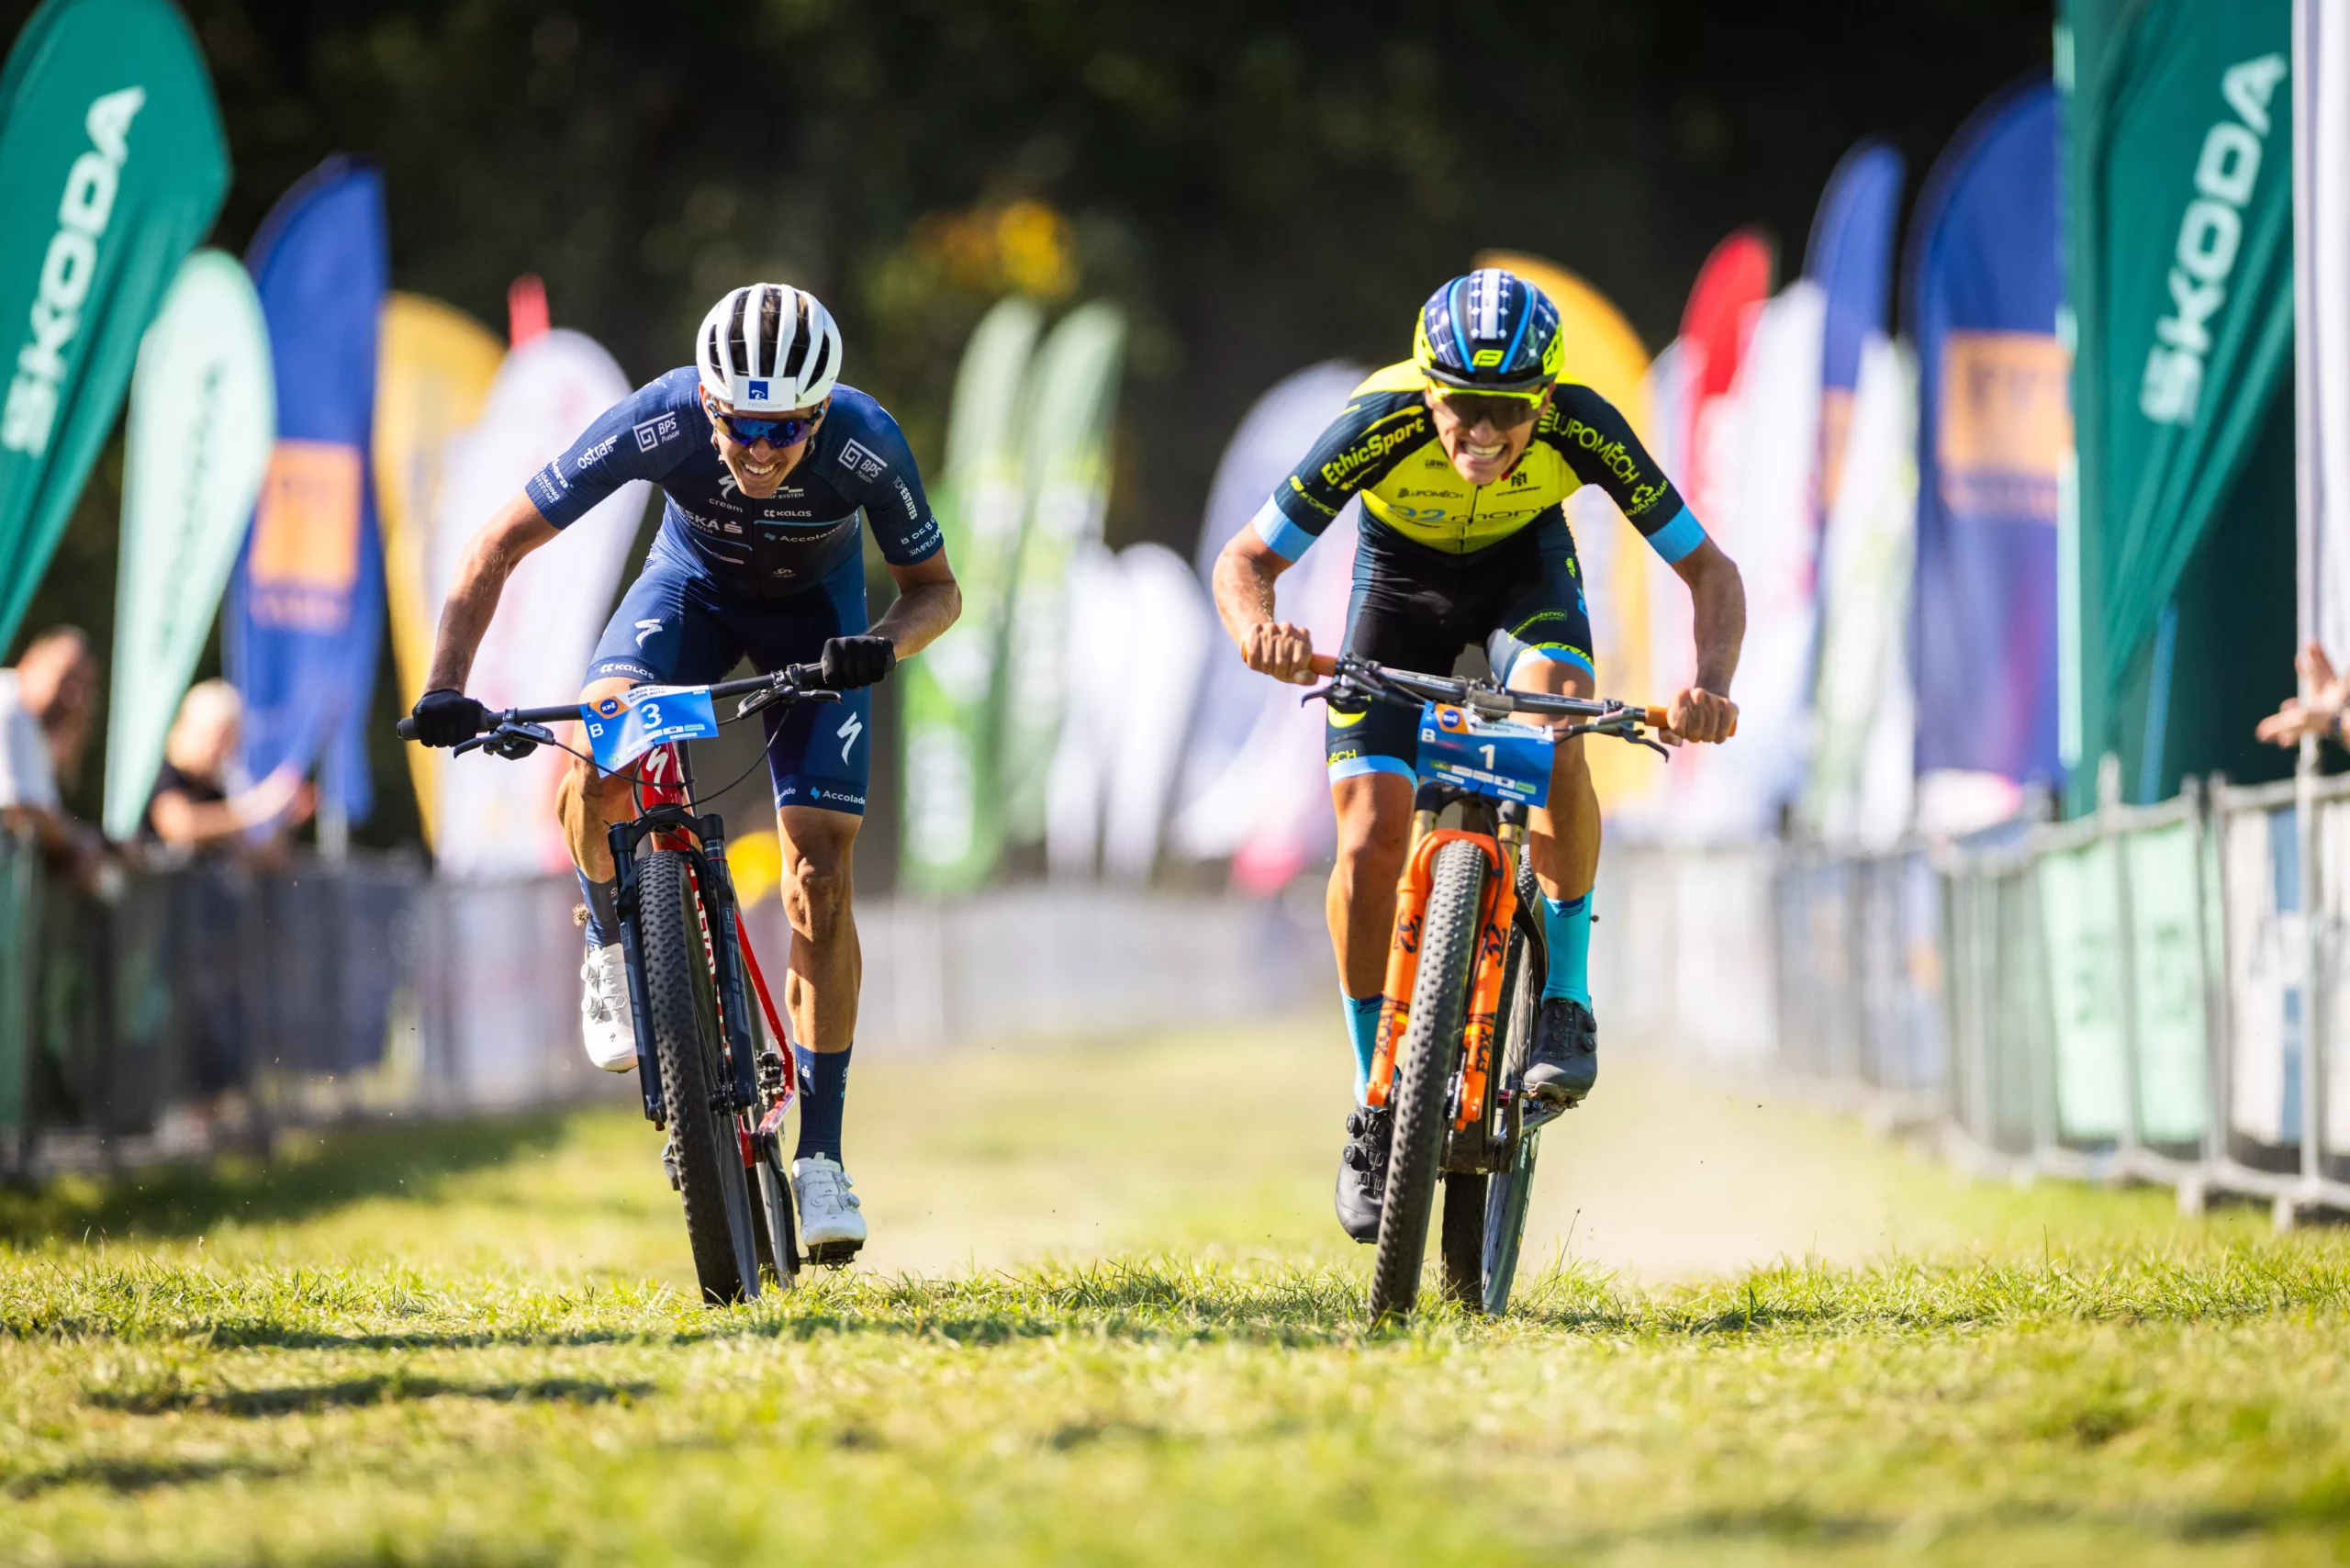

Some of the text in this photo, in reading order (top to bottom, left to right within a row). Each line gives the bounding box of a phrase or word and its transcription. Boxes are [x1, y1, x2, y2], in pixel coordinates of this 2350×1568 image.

[658, 417, 677, 435] BPS
[1321, 418, 1425, 486] EthicSport
[860, 459, 883, 478] BPS
[534, 476, 555, 503] SYSTEMS
[540, 471, 560, 500] LOADING
[892, 476, 918, 520] TOPESTATES
[677, 503, 721, 531] ESKÁ
[709, 498, 744, 513] cream
[602, 701, 616, 711] KPŽ
[641, 703, 662, 729] 3
[589, 722, 604, 738] B
[1421, 728, 1436, 743] B
[1478, 744, 1495, 769] 1
[822, 790, 865, 805] Accolade
[1375, 1014, 1394, 1056] FOX
[1475, 1027, 1494, 1072] FOX
